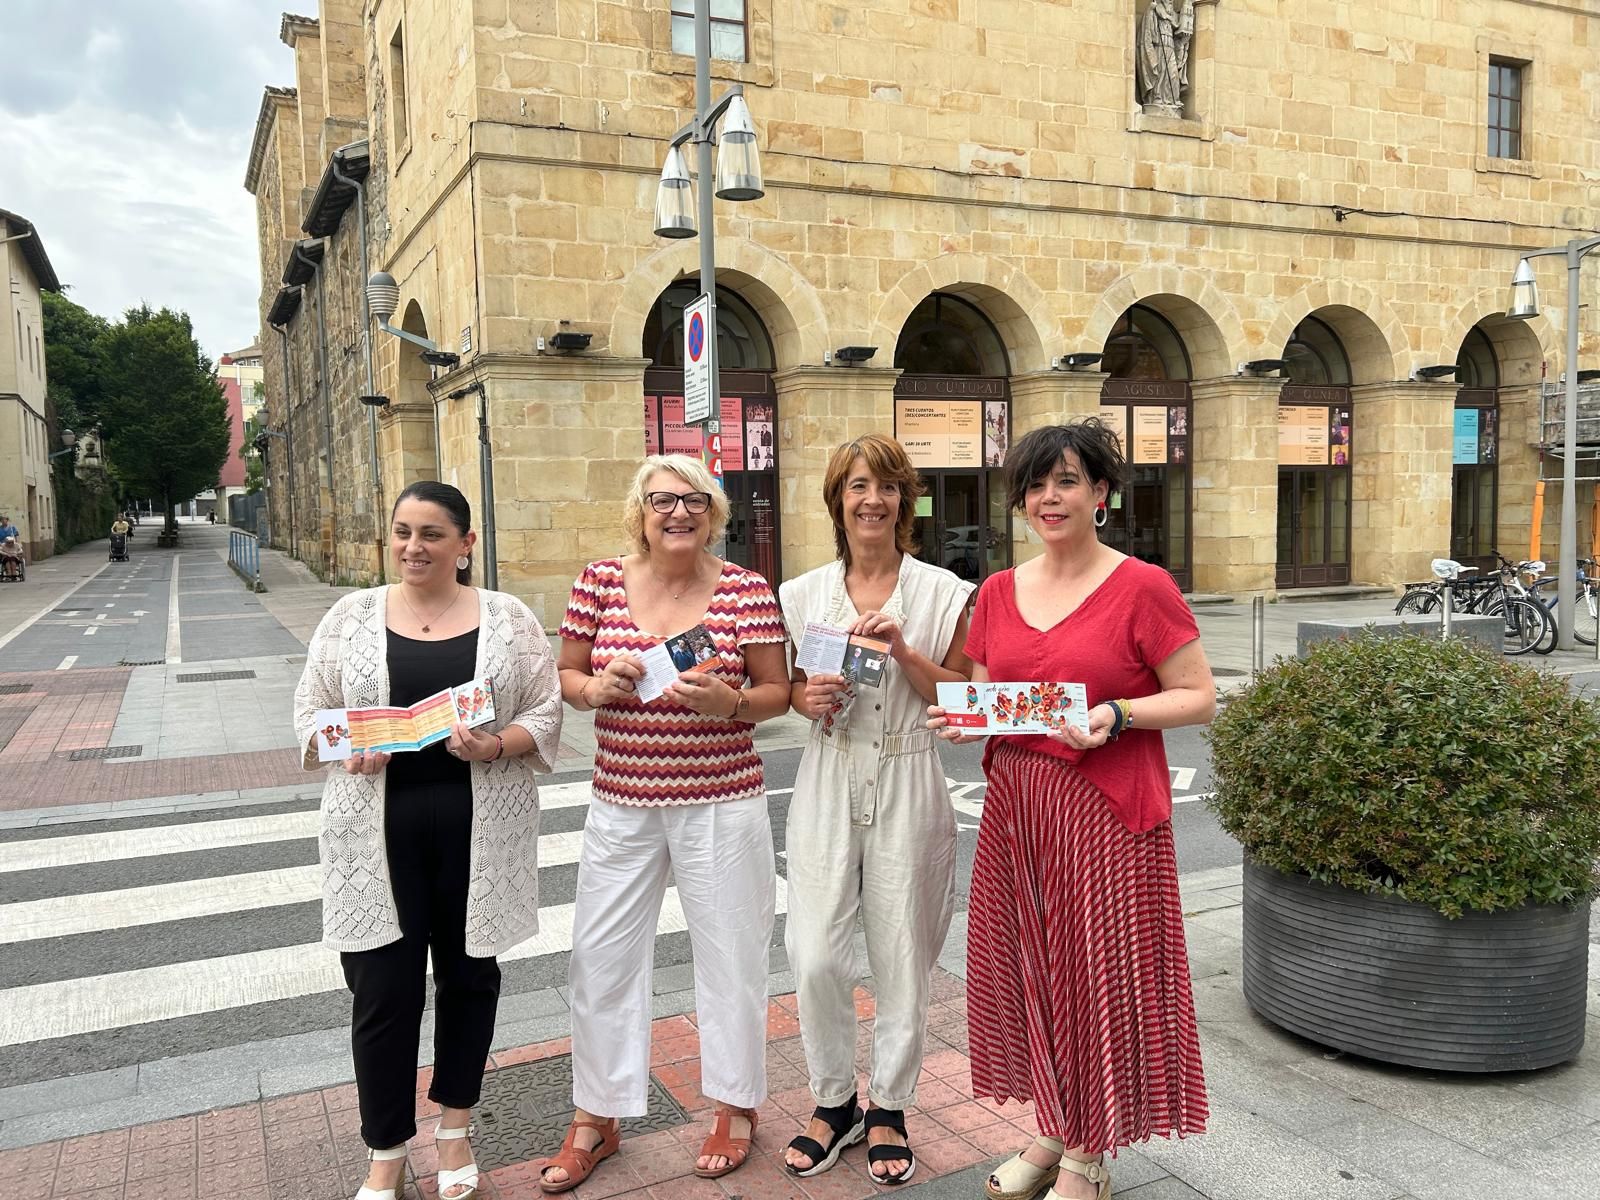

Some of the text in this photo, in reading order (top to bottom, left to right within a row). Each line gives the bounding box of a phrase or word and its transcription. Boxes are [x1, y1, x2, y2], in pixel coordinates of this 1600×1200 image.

[896, 380, 928, 393] ACIO
[712, 435, 721, 453] 4
[713, 458, 722, 475] 4
